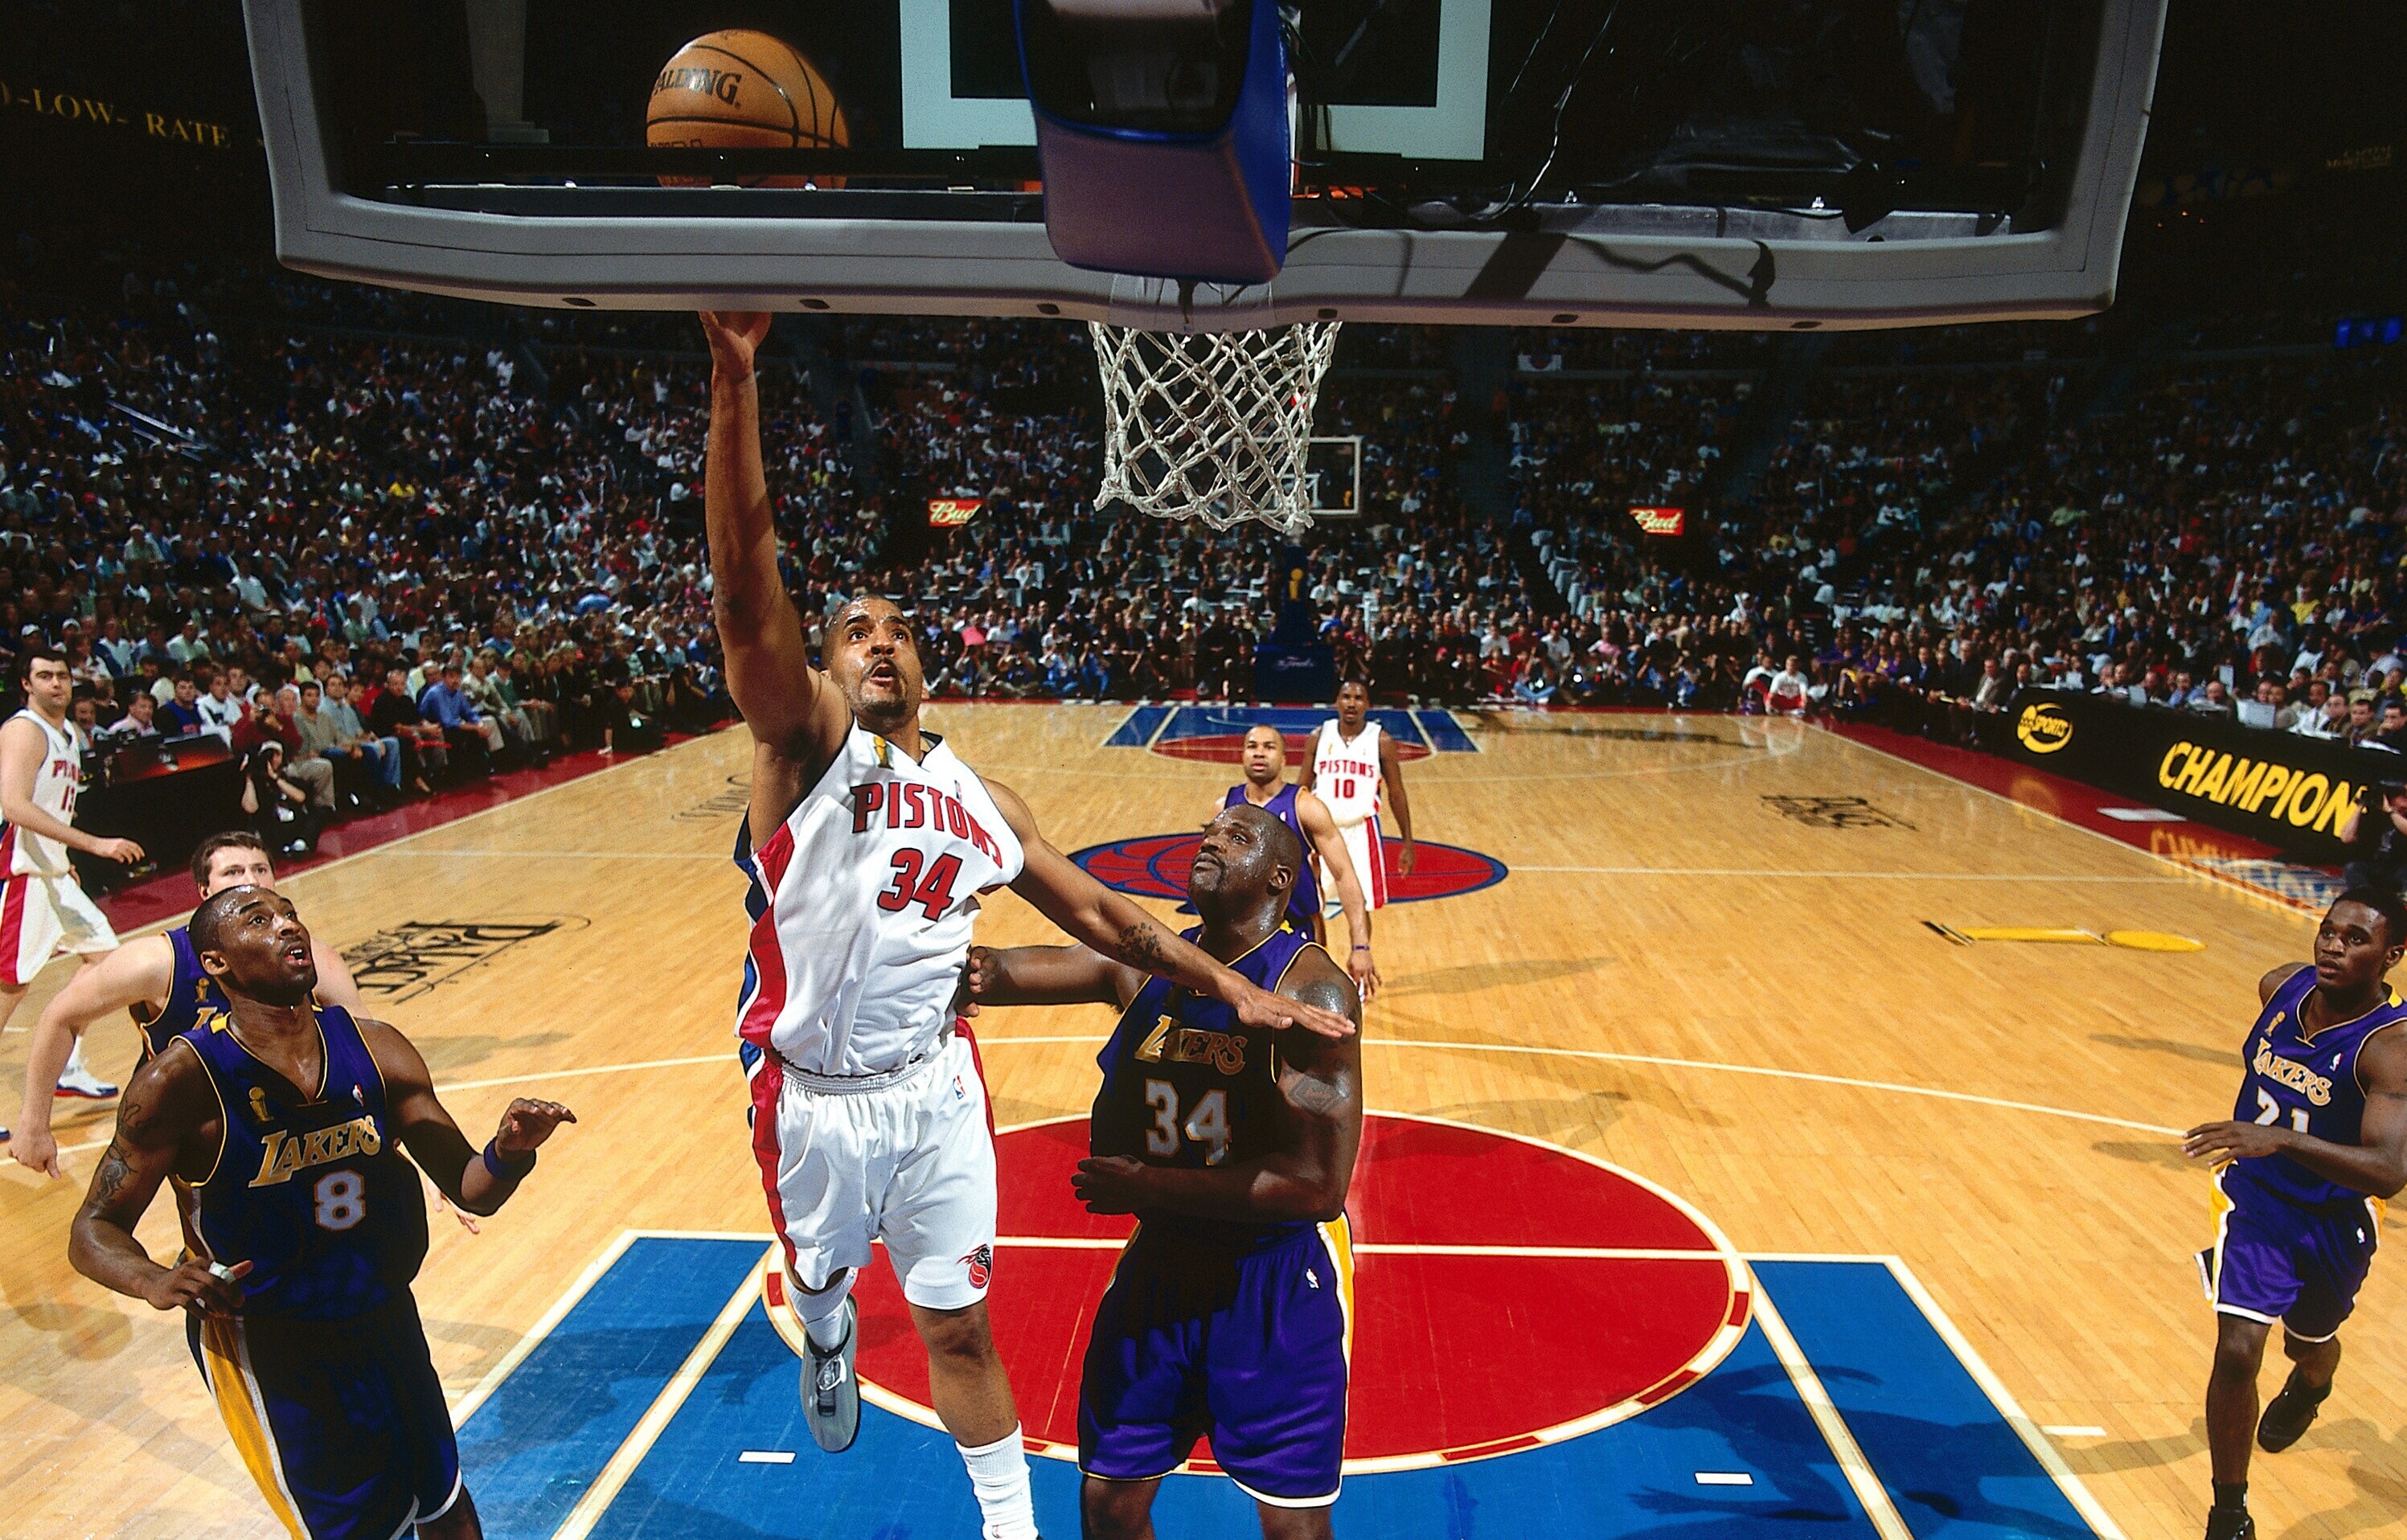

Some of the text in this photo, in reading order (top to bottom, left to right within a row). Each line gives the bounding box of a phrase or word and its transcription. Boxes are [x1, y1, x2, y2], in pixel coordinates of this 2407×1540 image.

[146, 113, 231, 147] RATE
[929, 502, 981, 522] Bud
[1630, 510, 1681, 530] Bud
[1319, 760, 1375, 778] PISTONS
[1335, 778, 1355, 798] 10
[2159, 741, 2368, 838] CHAMPION
[850, 782, 1003, 869] PISTONS
[877, 847, 963, 922] 34
[2253, 1037, 2332, 1106] LAKERS
[1146, 1079, 1232, 1165] 34
[2253, 1086, 2310, 1134] 21
[248, 1115, 381, 1188] LAKERS
[314, 1169, 366, 1231] 8
